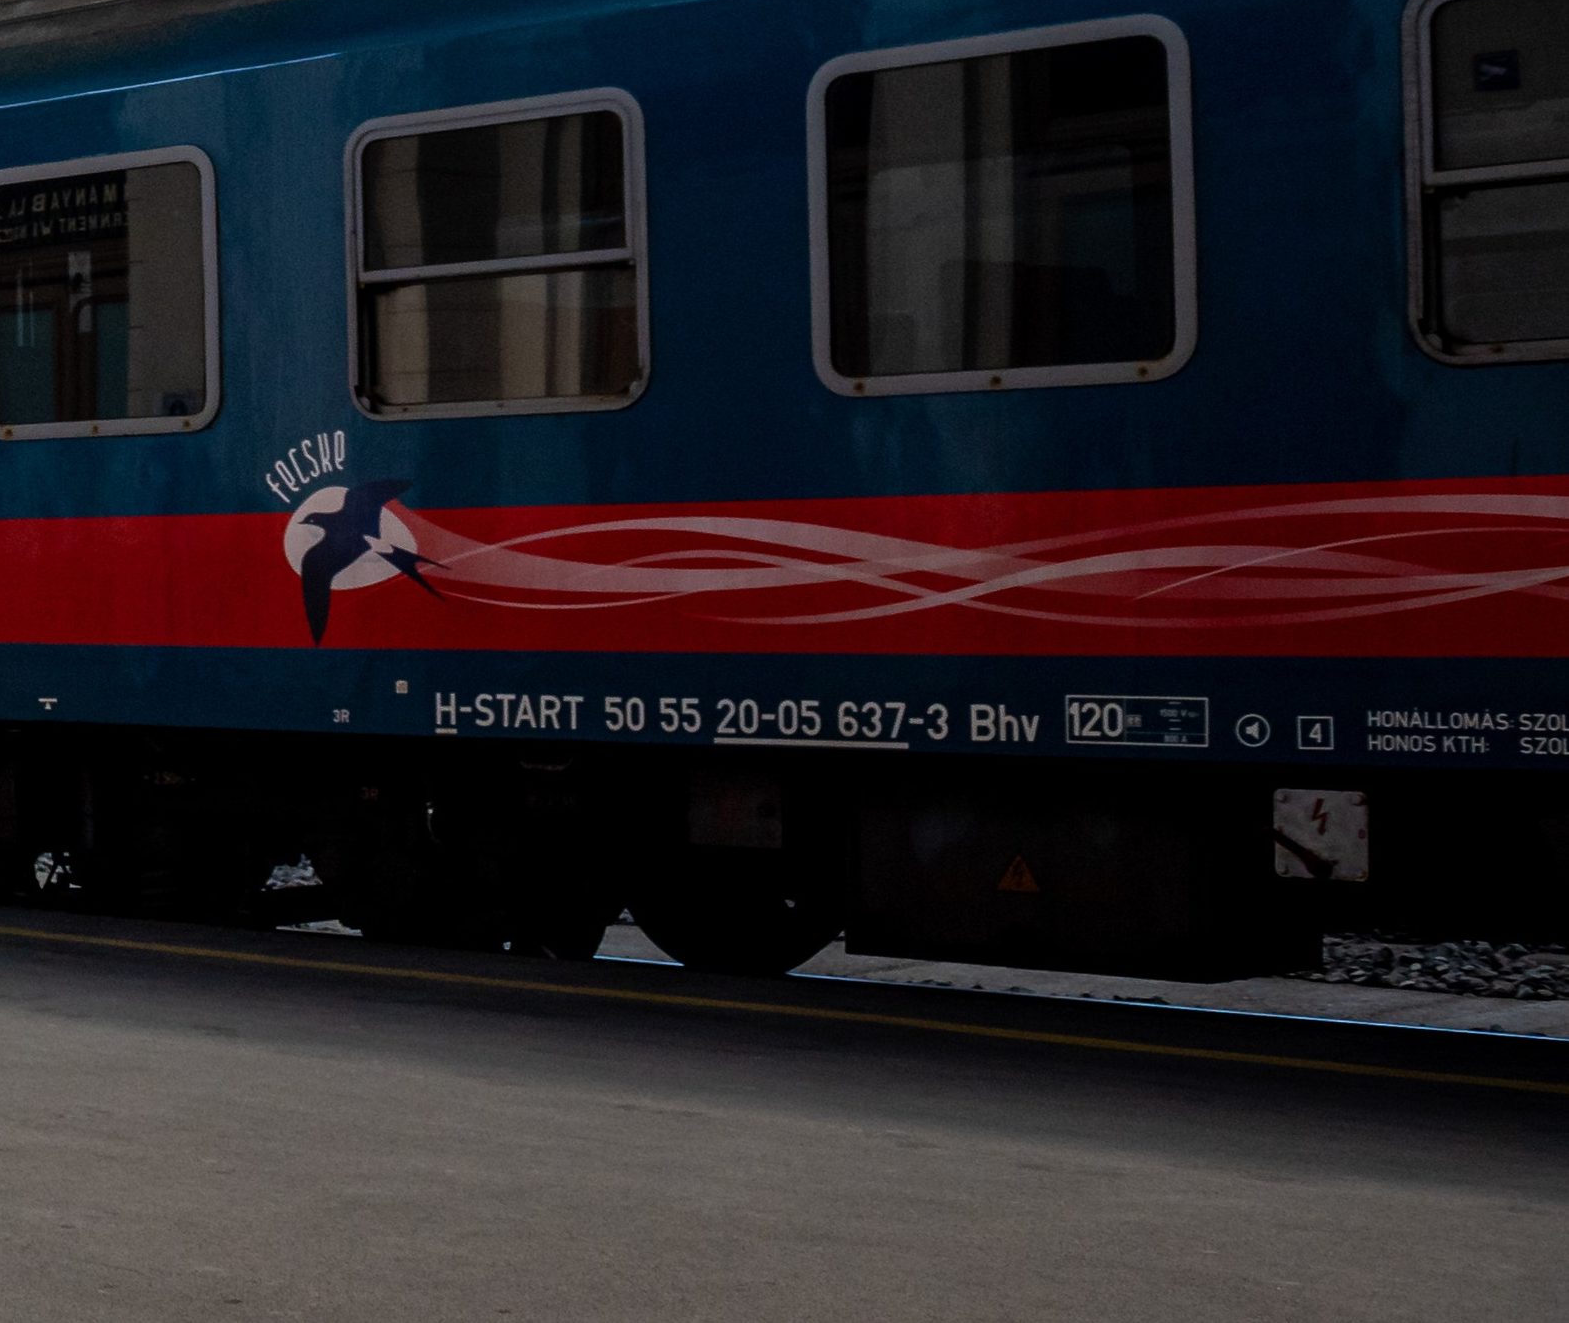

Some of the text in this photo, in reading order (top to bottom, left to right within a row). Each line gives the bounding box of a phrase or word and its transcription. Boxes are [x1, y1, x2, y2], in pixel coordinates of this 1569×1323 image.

[332, 708, 350, 724] 3R
[434, 692, 1040, 742] H-START 50 55 20-05 637-3 Bhv
[1069, 702, 1124, 738] 120
[1308, 722, 1322, 744] 4
[1367, 734, 1437, 753] HONOS
[1442, 735, 1491, 754] KTH:
